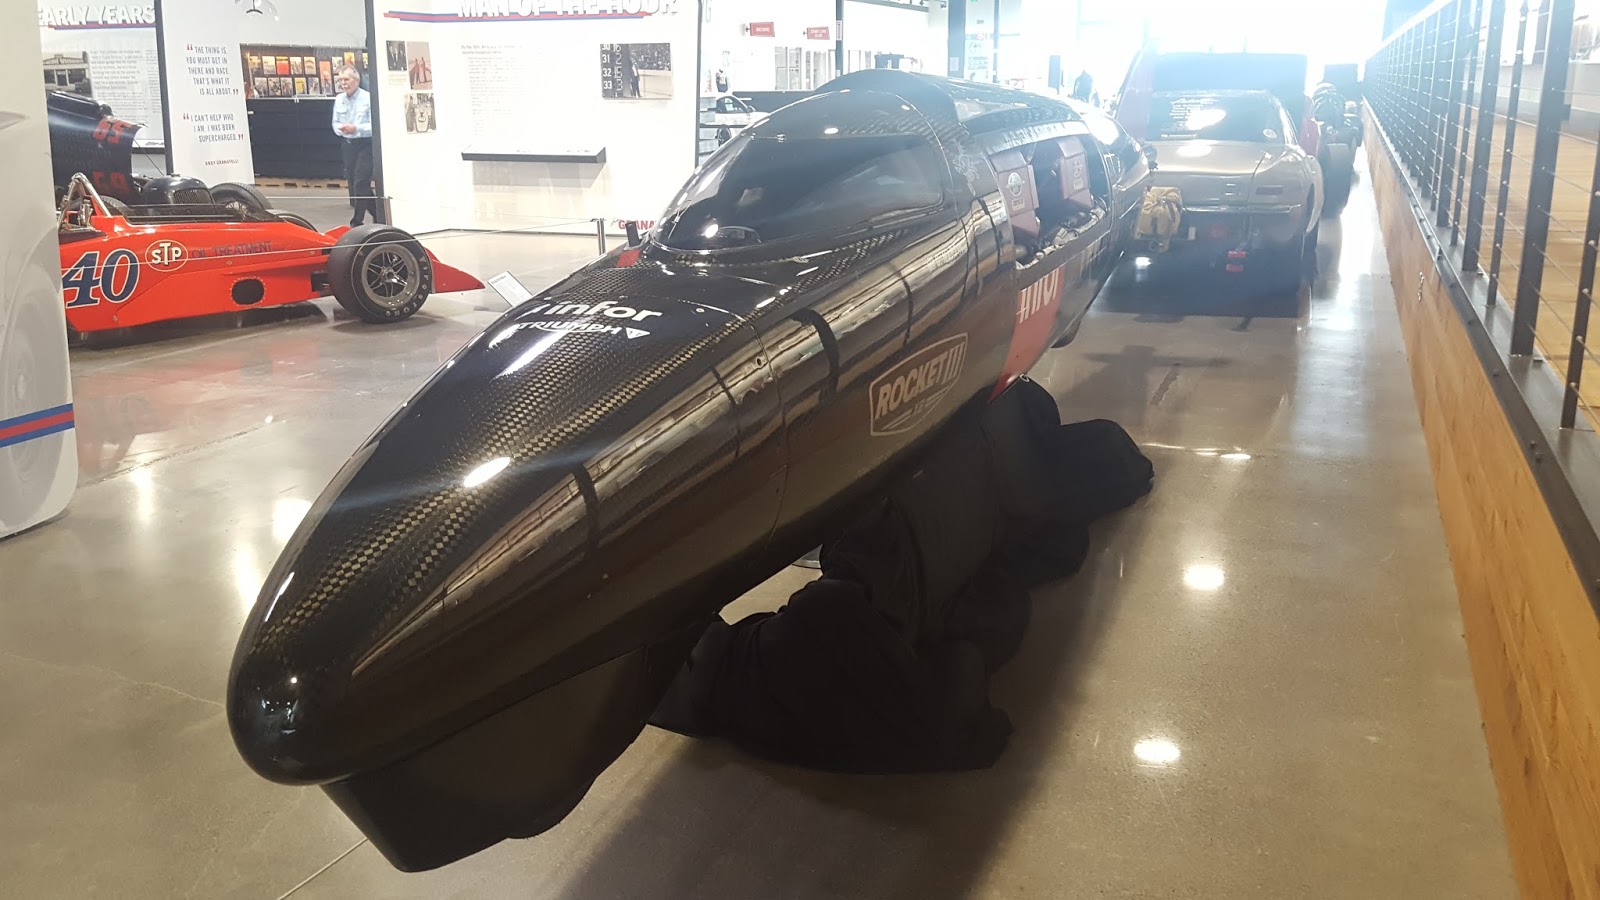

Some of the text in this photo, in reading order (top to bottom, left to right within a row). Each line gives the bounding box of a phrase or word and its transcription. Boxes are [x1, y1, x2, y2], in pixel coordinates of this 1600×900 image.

[94, 5, 155, 24] YEARS
[186, 56, 196, 64] YOU
[197, 56, 211, 64] MUST
[211, 56, 221, 64] GET
[601, 54, 610, 63] 31
[188, 67, 204, 75] THERE
[205, 67, 215, 75] AND
[602, 67, 612, 77] 32
[210, 77, 224, 85] WHAT
[224, 77, 230, 85] IT
[603, 80, 613, 90] 33
[209, 113, 222, 122] HELP
[222, 113, 234, 121] WHO
[210, 124, 221, 132] WAS
[151, 242, 182, 266] STP
[191, 241, 273, 259] OIL TREATMENT
[61, 249, 141, 309] 40
[543, 301, 663, 321] infor
[518, 321, 623, 334] TRIUMPH
